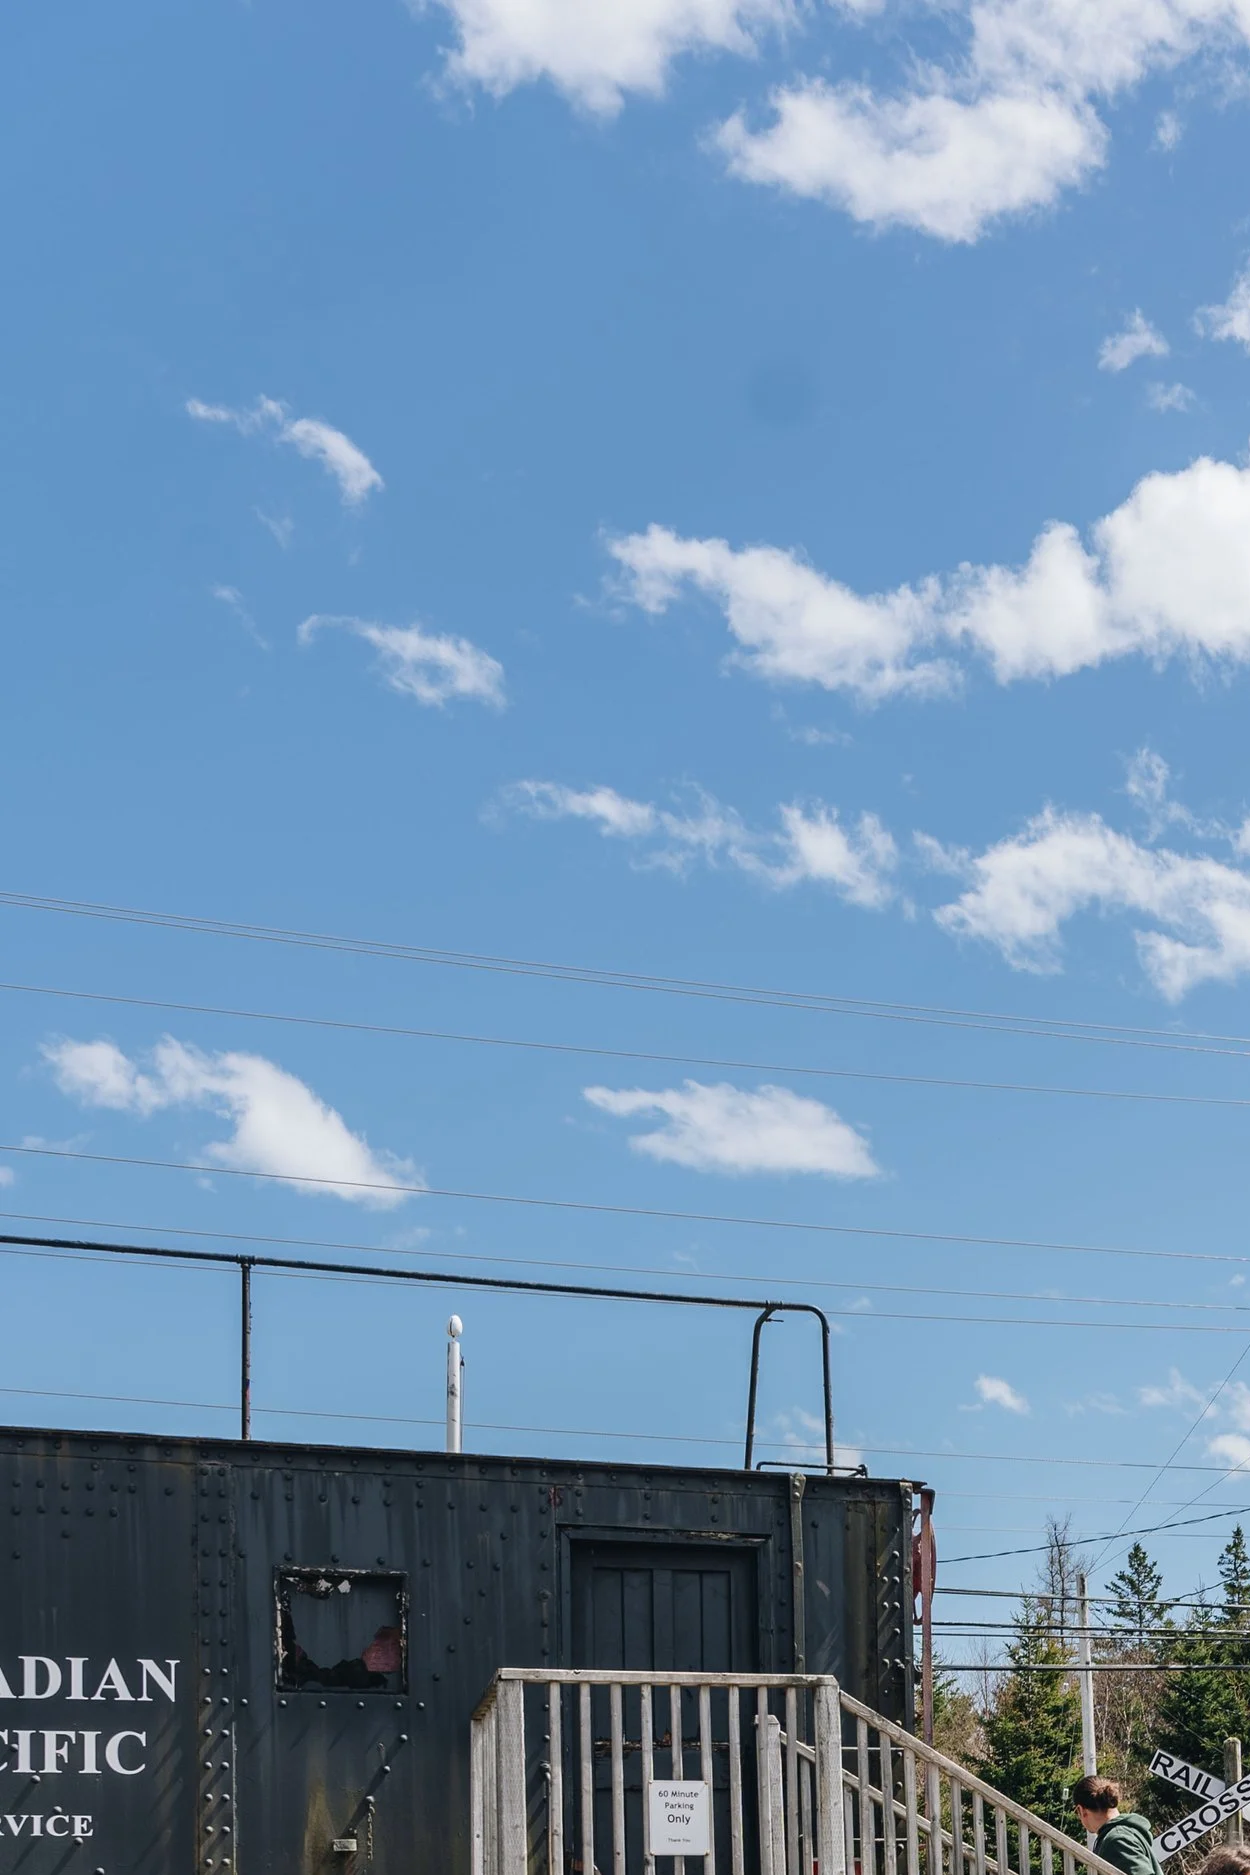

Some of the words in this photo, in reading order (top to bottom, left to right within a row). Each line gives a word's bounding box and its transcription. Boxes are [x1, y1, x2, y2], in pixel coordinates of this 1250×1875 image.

[0, 1729, 147, 1775] IFIC
[1151, 1752, 1214, 1800] RAIL
[658, 1790, 669, 1798] 60
[671, 1790, 699, 1798] Minute
[665, 1802, 694, 1810] Parking
[0, 1814, 94, 1836] VICE
[667, 1814, 691, 1825] Only
